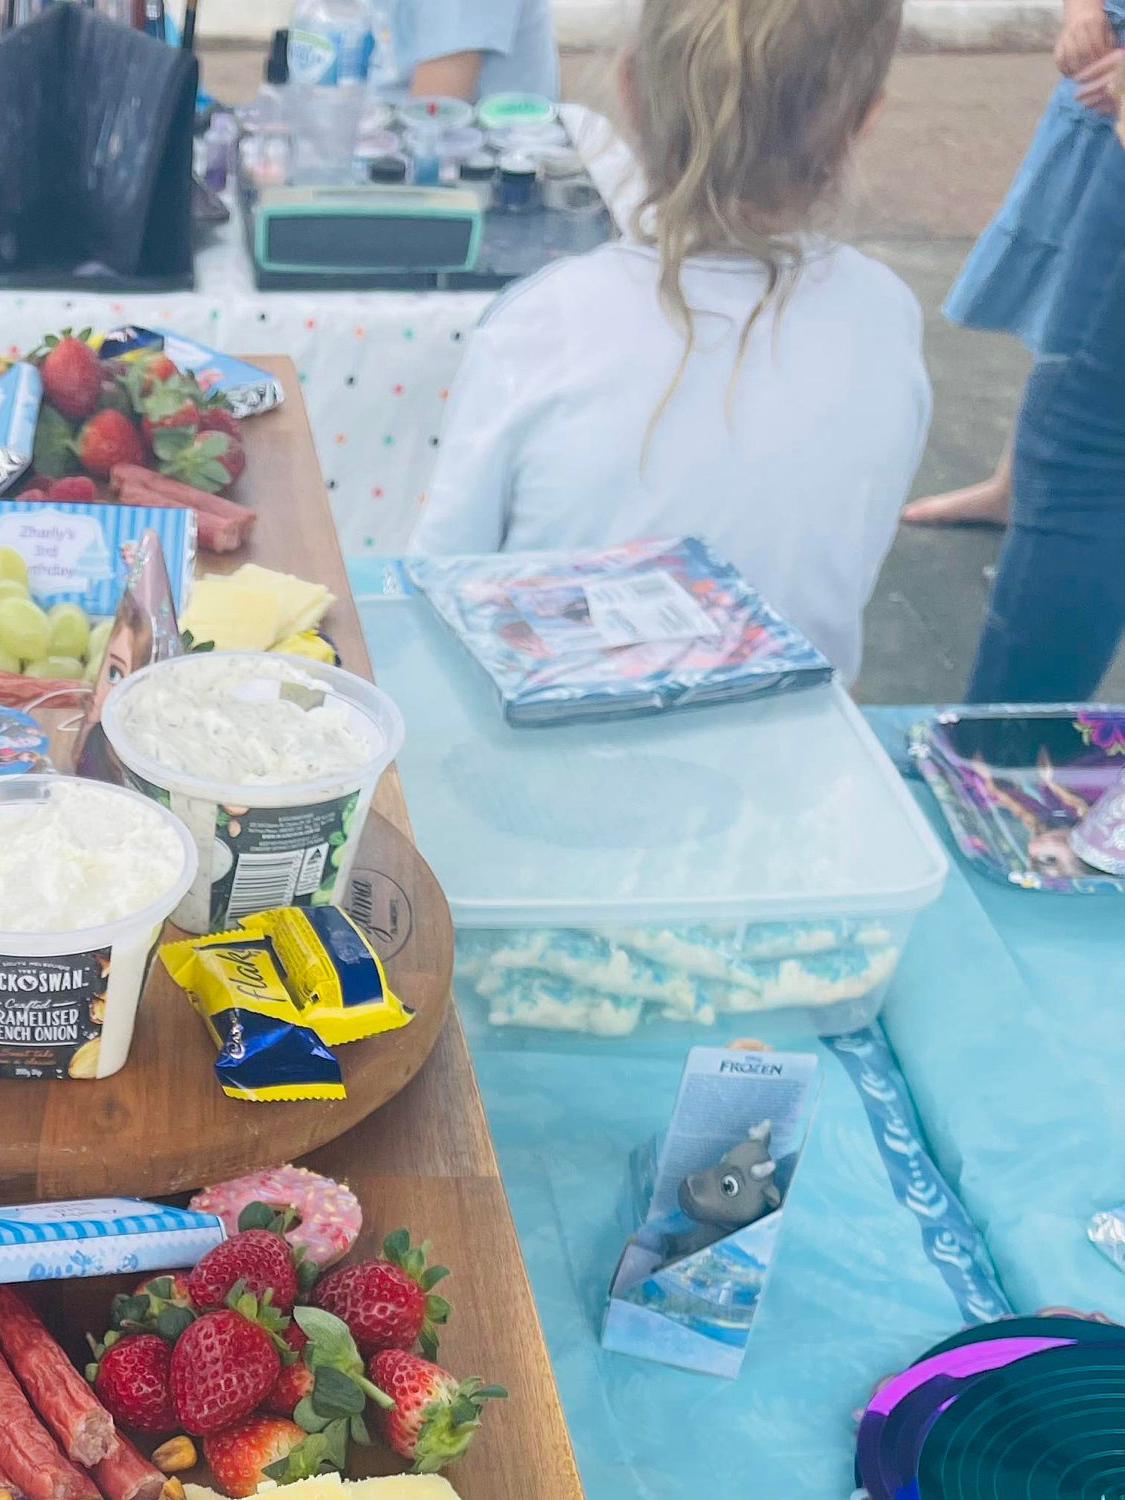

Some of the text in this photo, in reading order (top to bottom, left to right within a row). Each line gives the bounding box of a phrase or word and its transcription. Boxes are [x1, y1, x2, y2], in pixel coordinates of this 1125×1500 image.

[39, 968, 83, 993] SWAN
[35, 1025, 78, 1042] ONION
[719, 1060, 783, 1075] FROZEN
